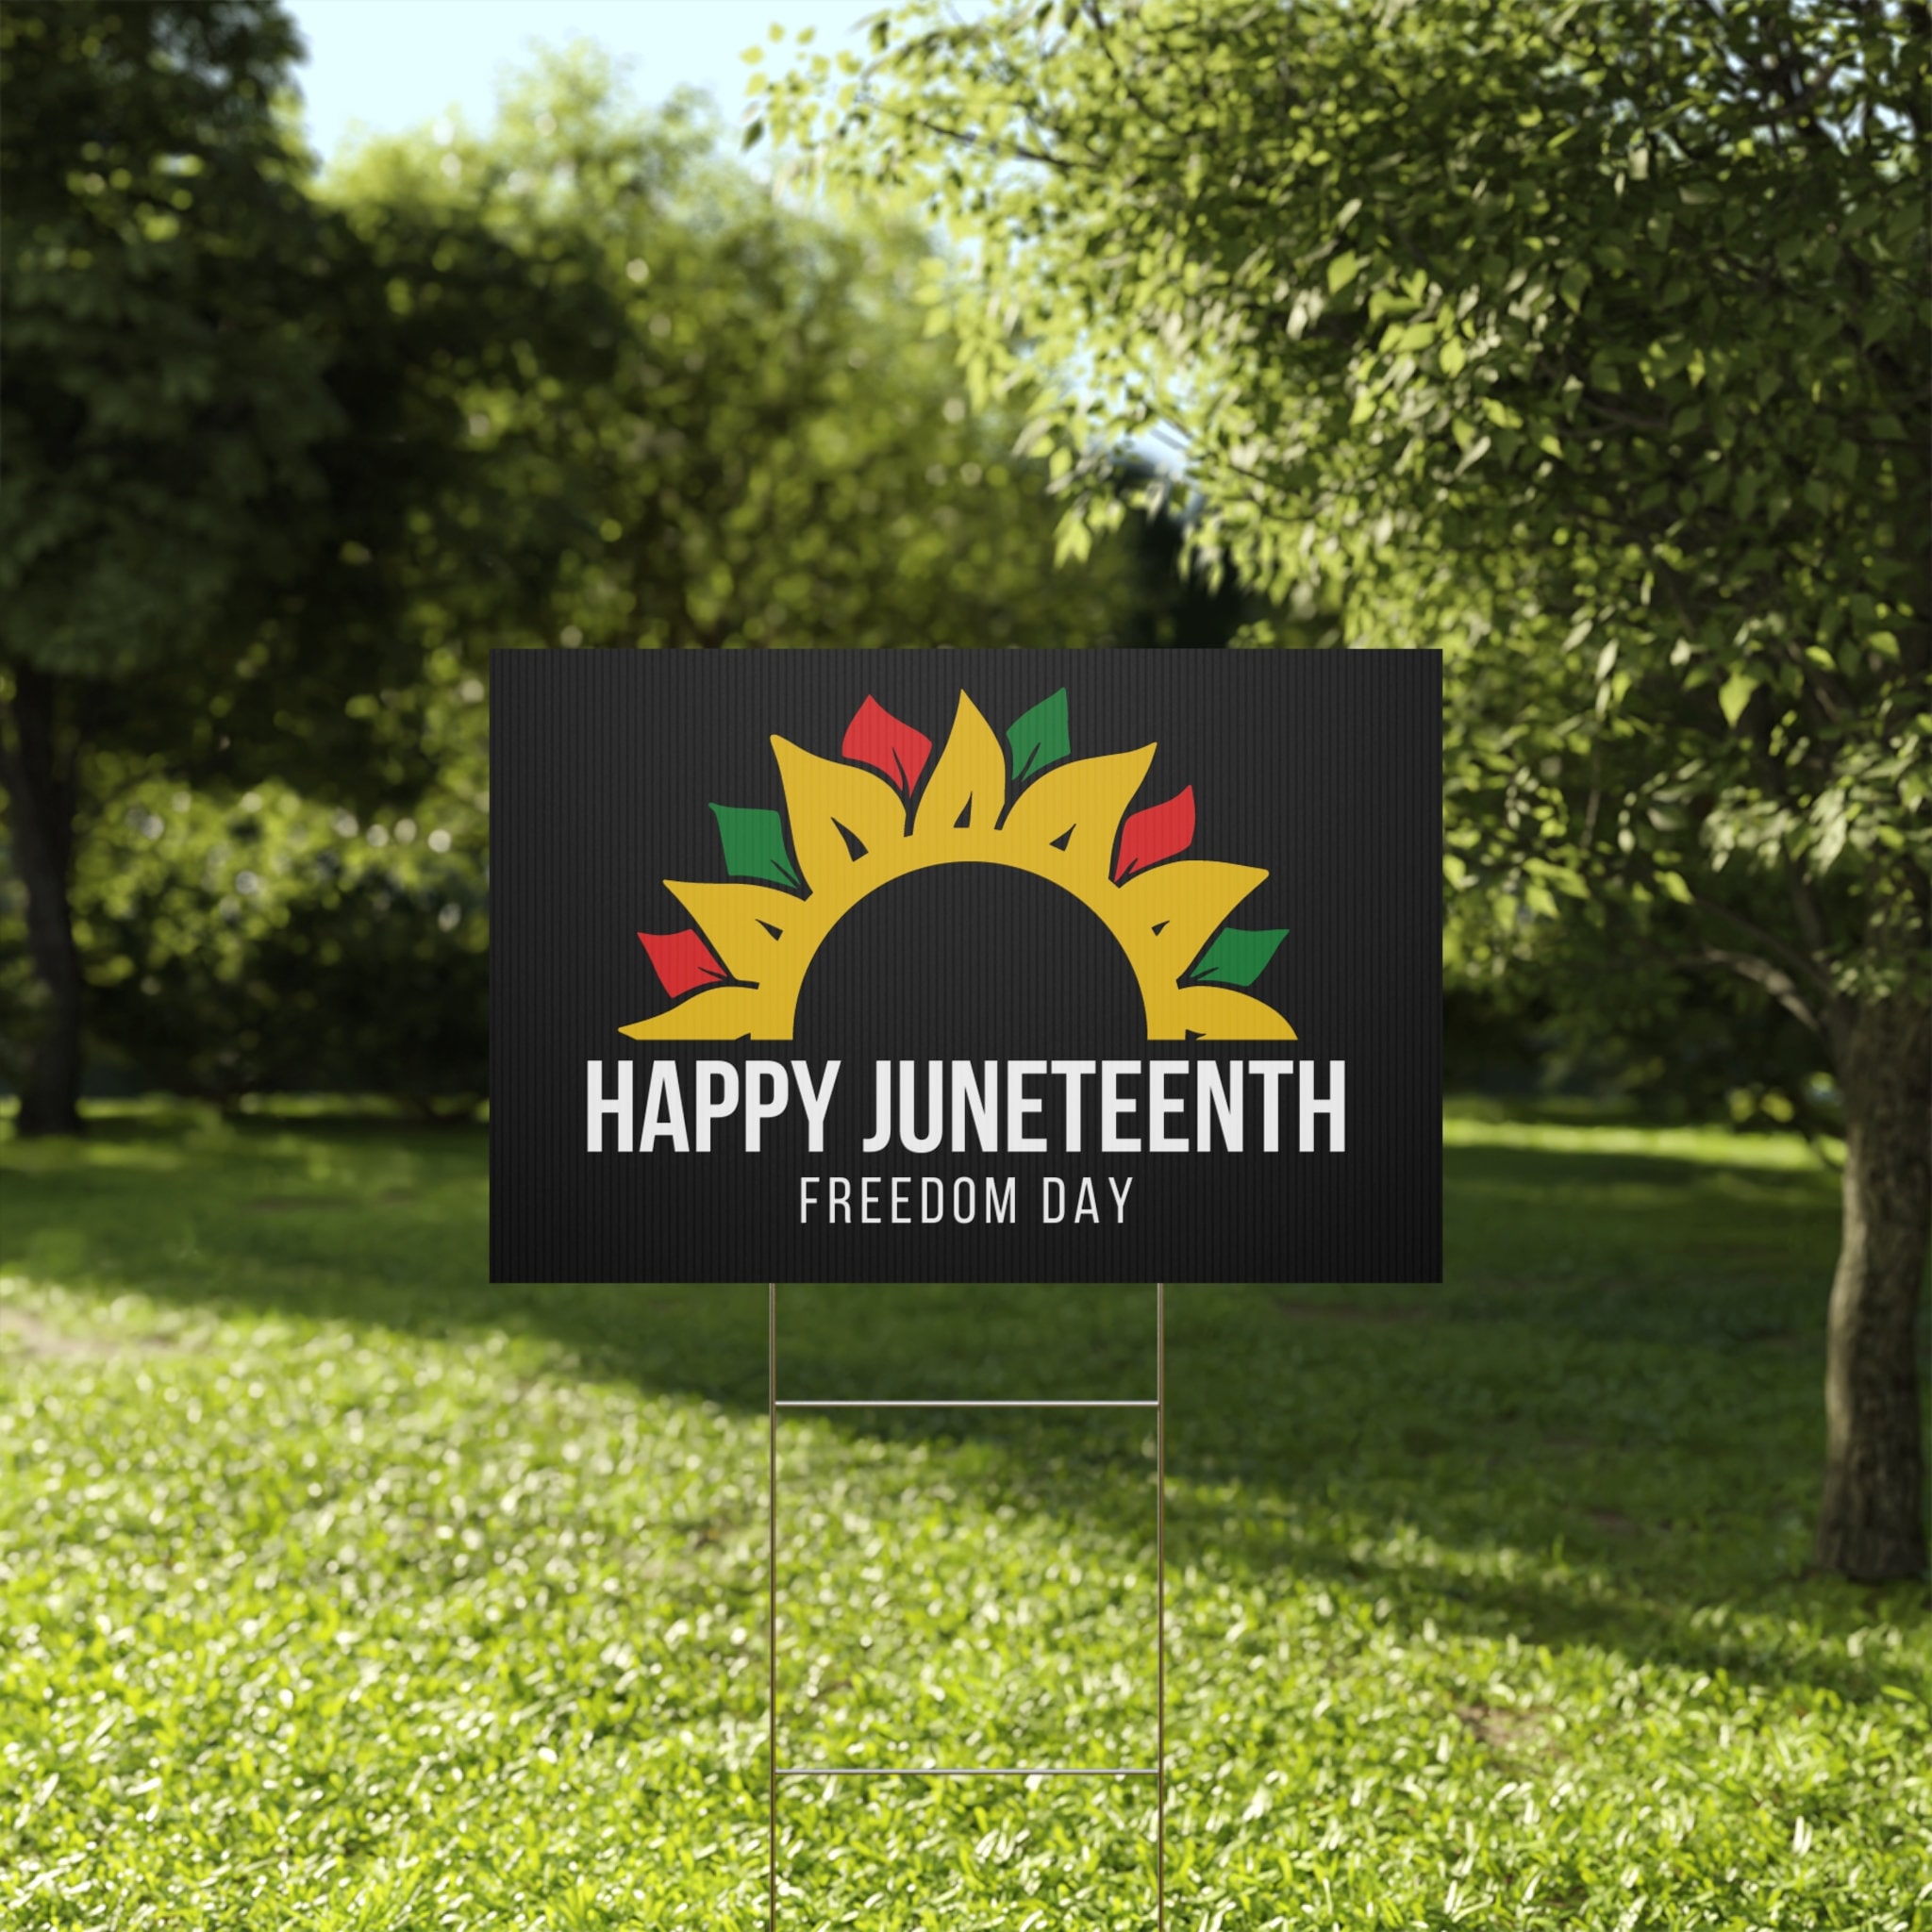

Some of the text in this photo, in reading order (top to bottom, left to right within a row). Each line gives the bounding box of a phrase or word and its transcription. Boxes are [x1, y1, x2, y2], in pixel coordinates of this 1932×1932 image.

[587, 1059, 1346, 1154] HAPPY JUNETEENTH
[800, 1175, 1133, 1224] FREEDOM DAY
